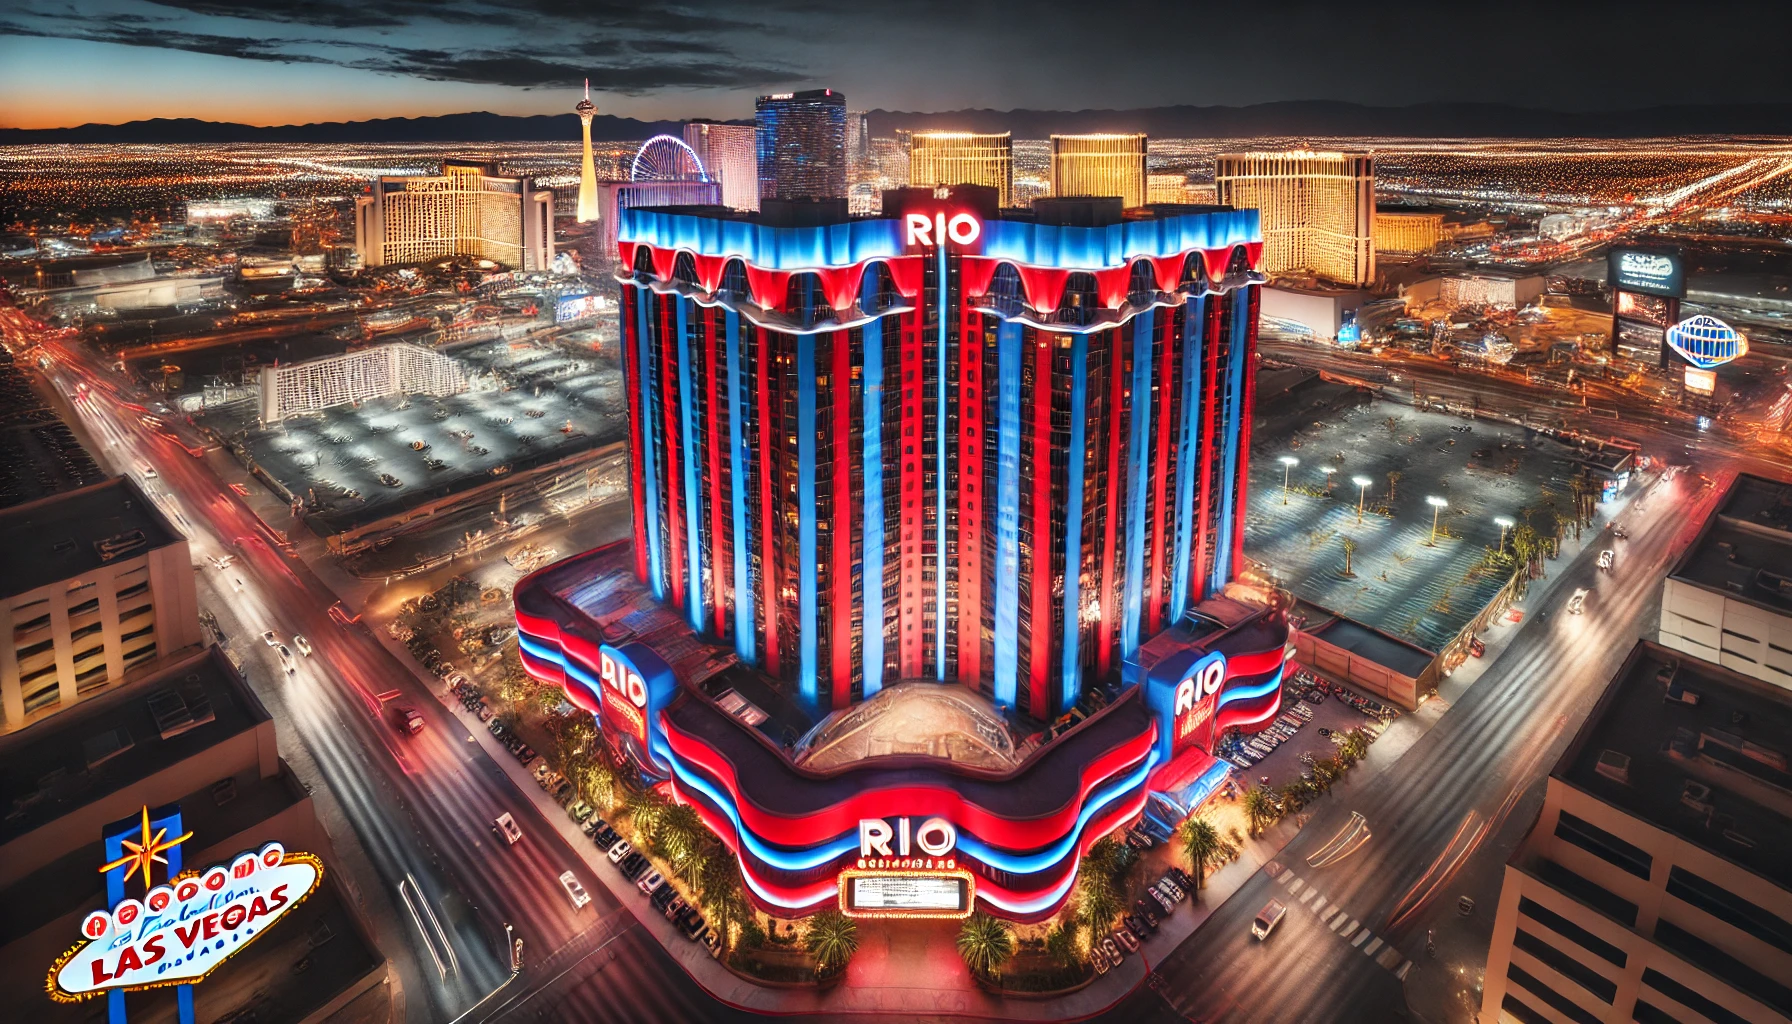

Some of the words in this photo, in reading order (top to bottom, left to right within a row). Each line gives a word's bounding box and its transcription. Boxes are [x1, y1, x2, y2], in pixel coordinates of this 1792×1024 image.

[906, 212, 980, 245] RIO
[601, 652, 647, 708] RIO
[1175, 659, 1225, 716] RIO
[859, 817, 957, 857] RIO
[91, 934, 166, 986] LAS
[174, 884, 288, 949] VEGAS
